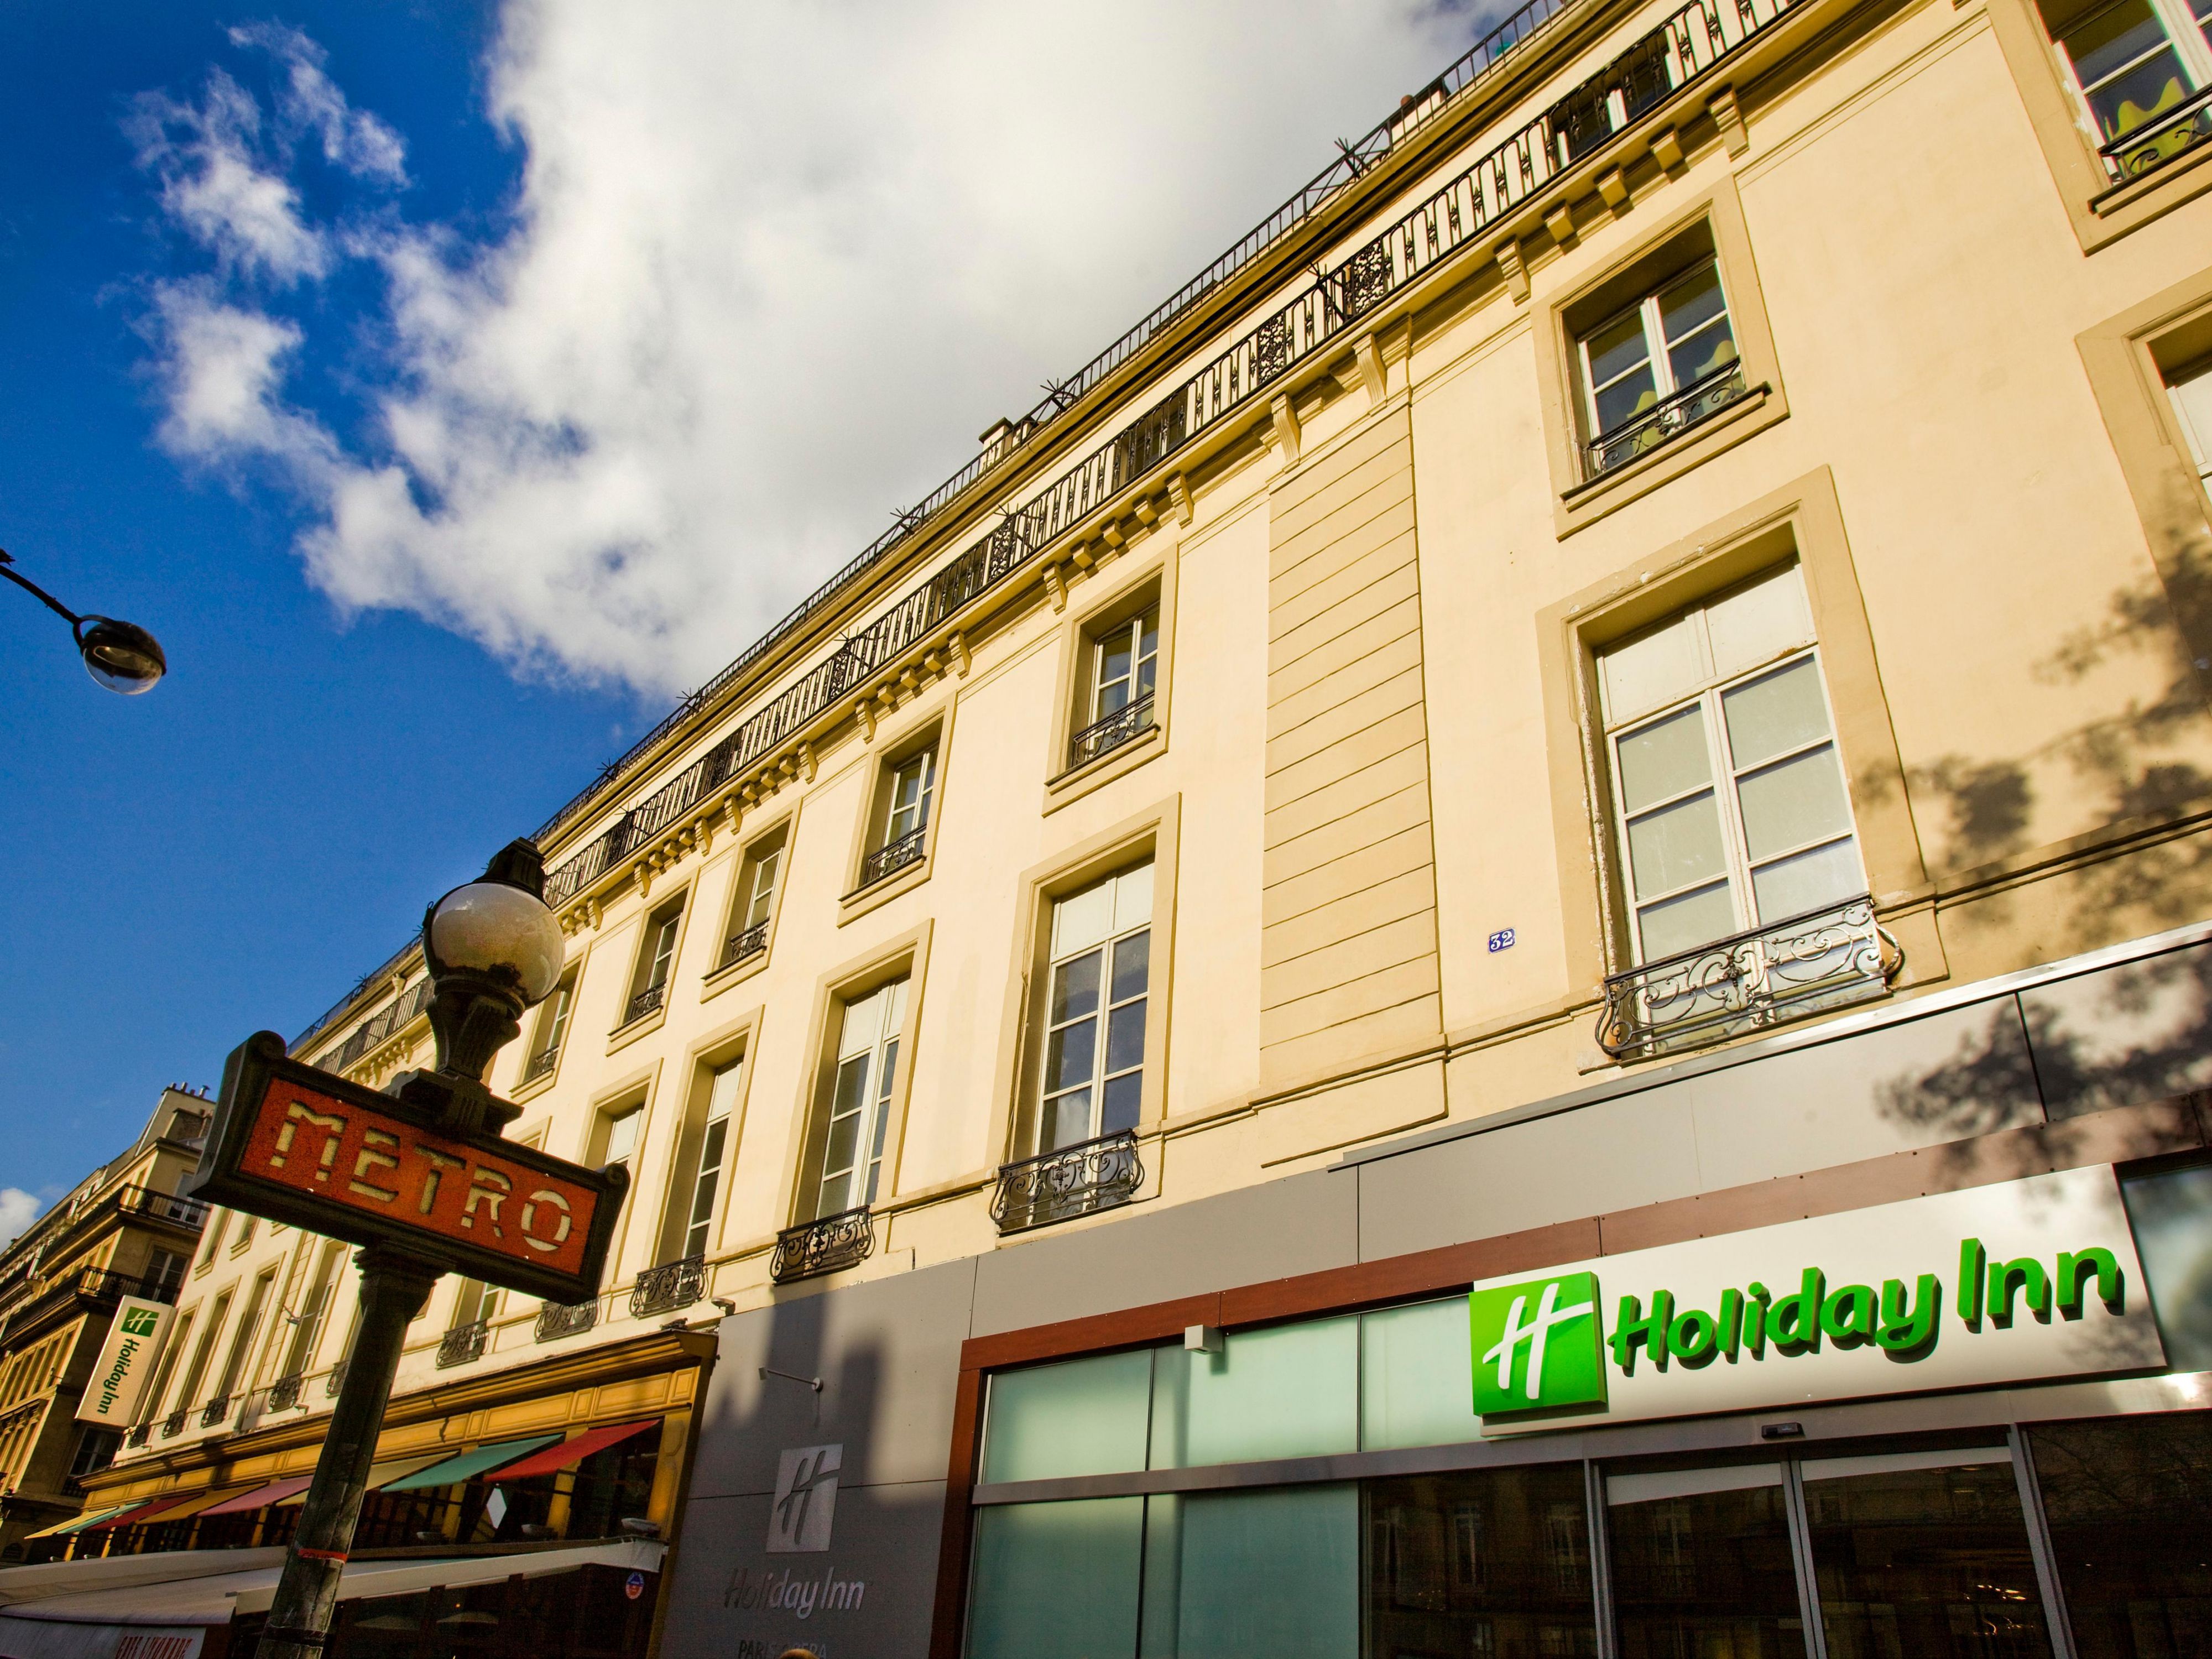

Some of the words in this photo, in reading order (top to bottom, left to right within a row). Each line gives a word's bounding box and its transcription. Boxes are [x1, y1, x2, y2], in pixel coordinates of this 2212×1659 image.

[1490, 930, 1513, 950] 32
[269, 1100, 572, 1251] METRO
[1606, 1266, 1940, 1370] Holiday
[1957, 1237, 2124, 1327] Inn
[103, 1338, 140, 1391] Holiday
[97, 1391, 119, 1415] Inn
[723, 1567, 820, 1620] Holiday
[820, 1566, 865, 1610] Inn
